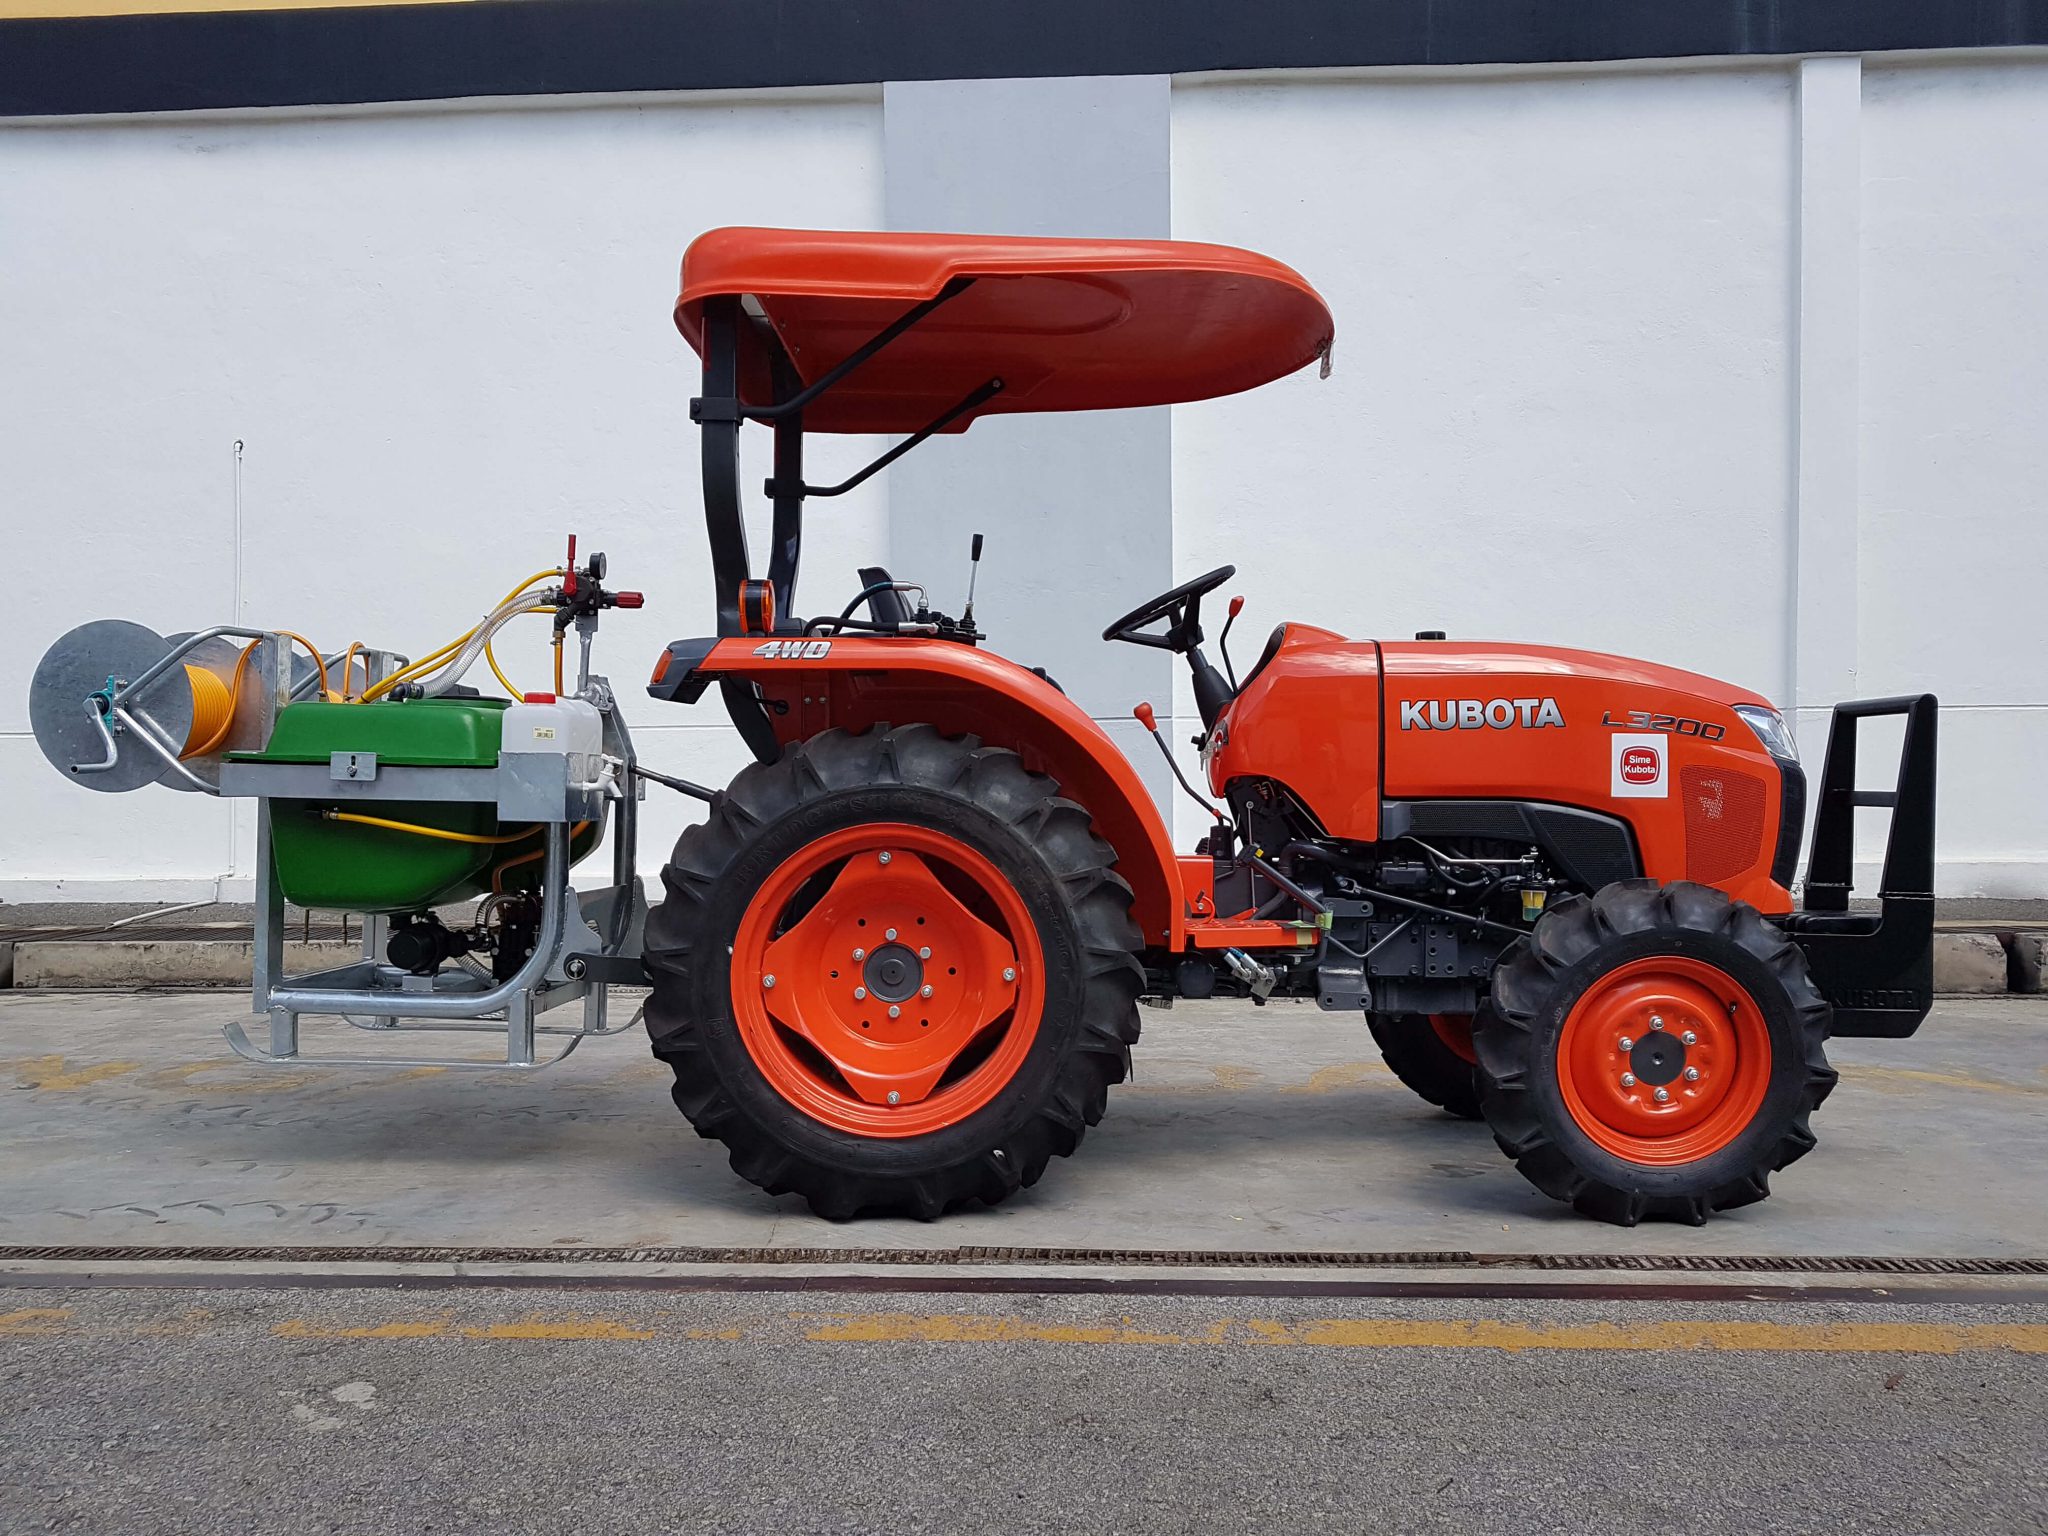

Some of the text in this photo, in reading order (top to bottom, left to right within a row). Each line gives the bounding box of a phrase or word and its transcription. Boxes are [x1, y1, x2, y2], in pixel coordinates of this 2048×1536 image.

[752, 641, 832, 660] 4WD
[1400, 697, 1566, 730] KUBOTA
[1601, 710, 1727, 742] L3200
[1629, 755, 1651, 764] Sime
[1624, 765, 1656, 774] Kubota
